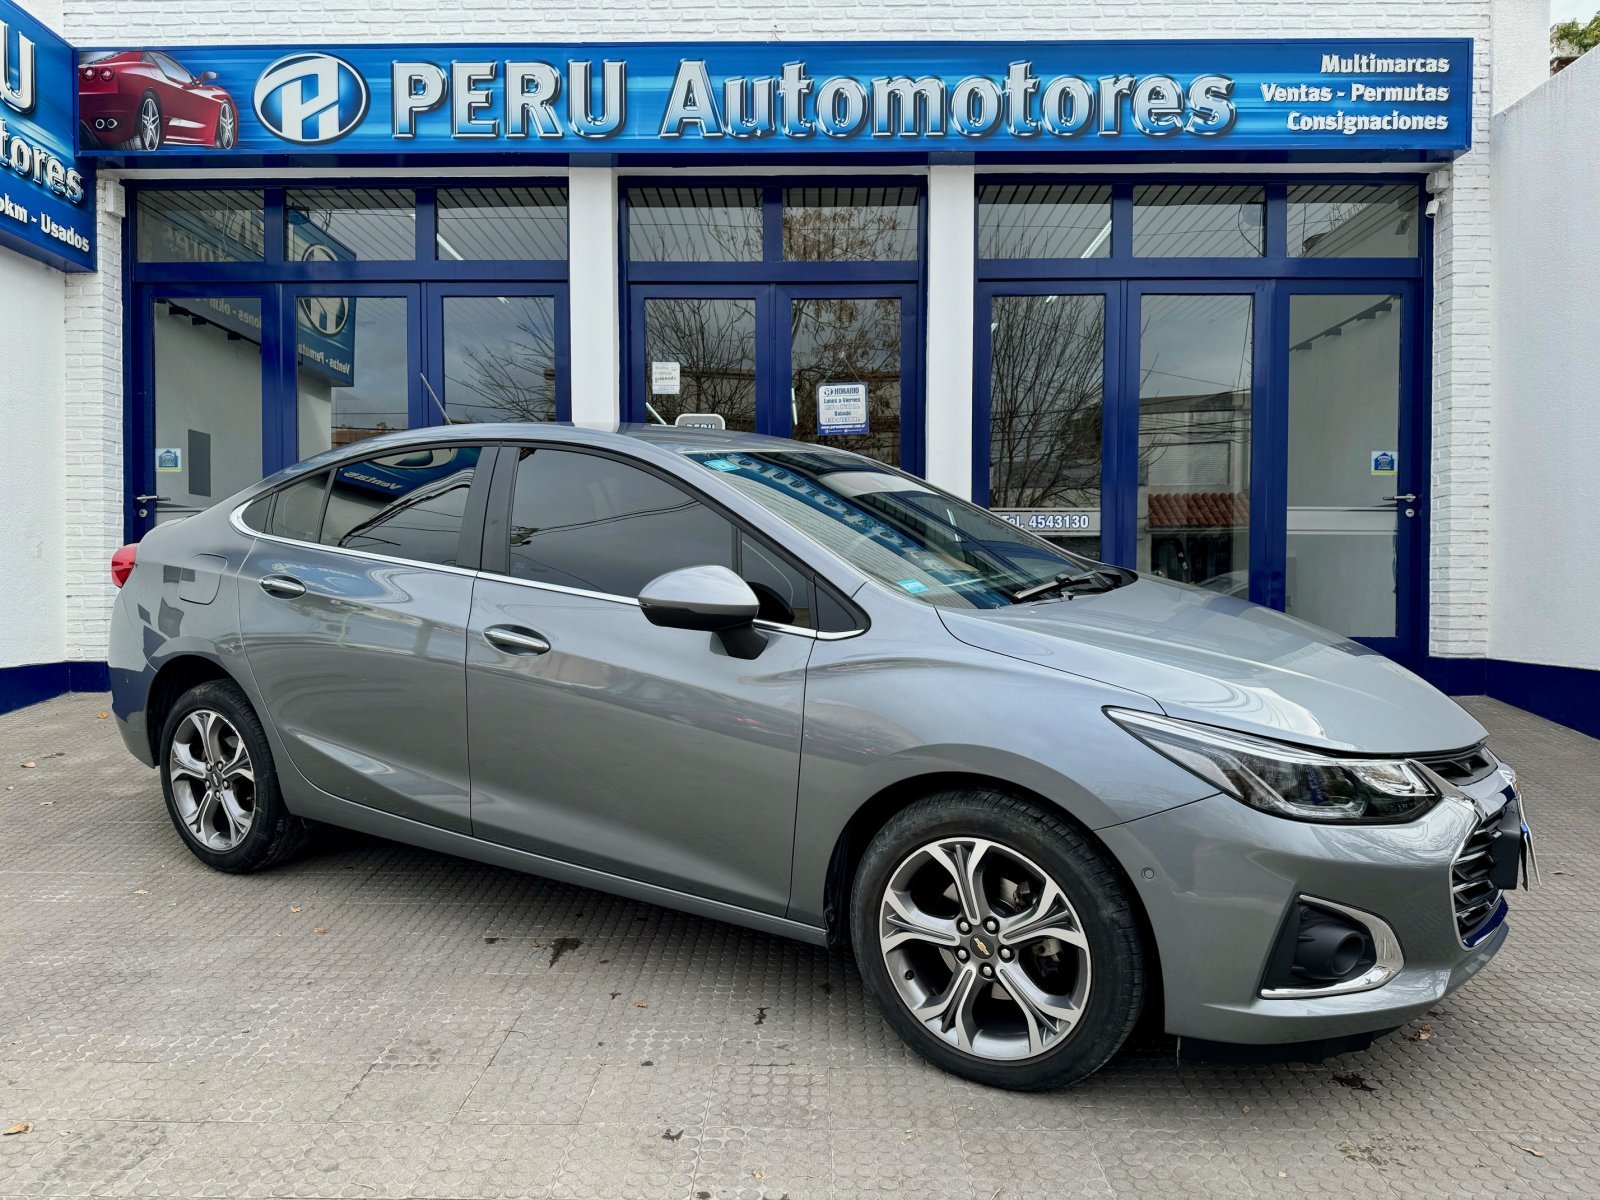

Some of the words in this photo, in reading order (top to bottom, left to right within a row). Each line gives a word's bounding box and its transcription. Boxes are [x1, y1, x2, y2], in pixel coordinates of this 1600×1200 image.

[1320, 53, 1450, 74] Multimarcas
[391, 60, 627, 140] PERU
[659, 59, 1237, 139] Automotores
[1261, 83, 1332, 102] Ventas
[1350, 83, 1449, 102] Permutas
[1287, 110, 1448, 134] Consignaciones
[40, 211, 90, 253] Usados
[834, 387, 860, 395] HORARIO
[1028, 515, 1089, 529] 4543130
